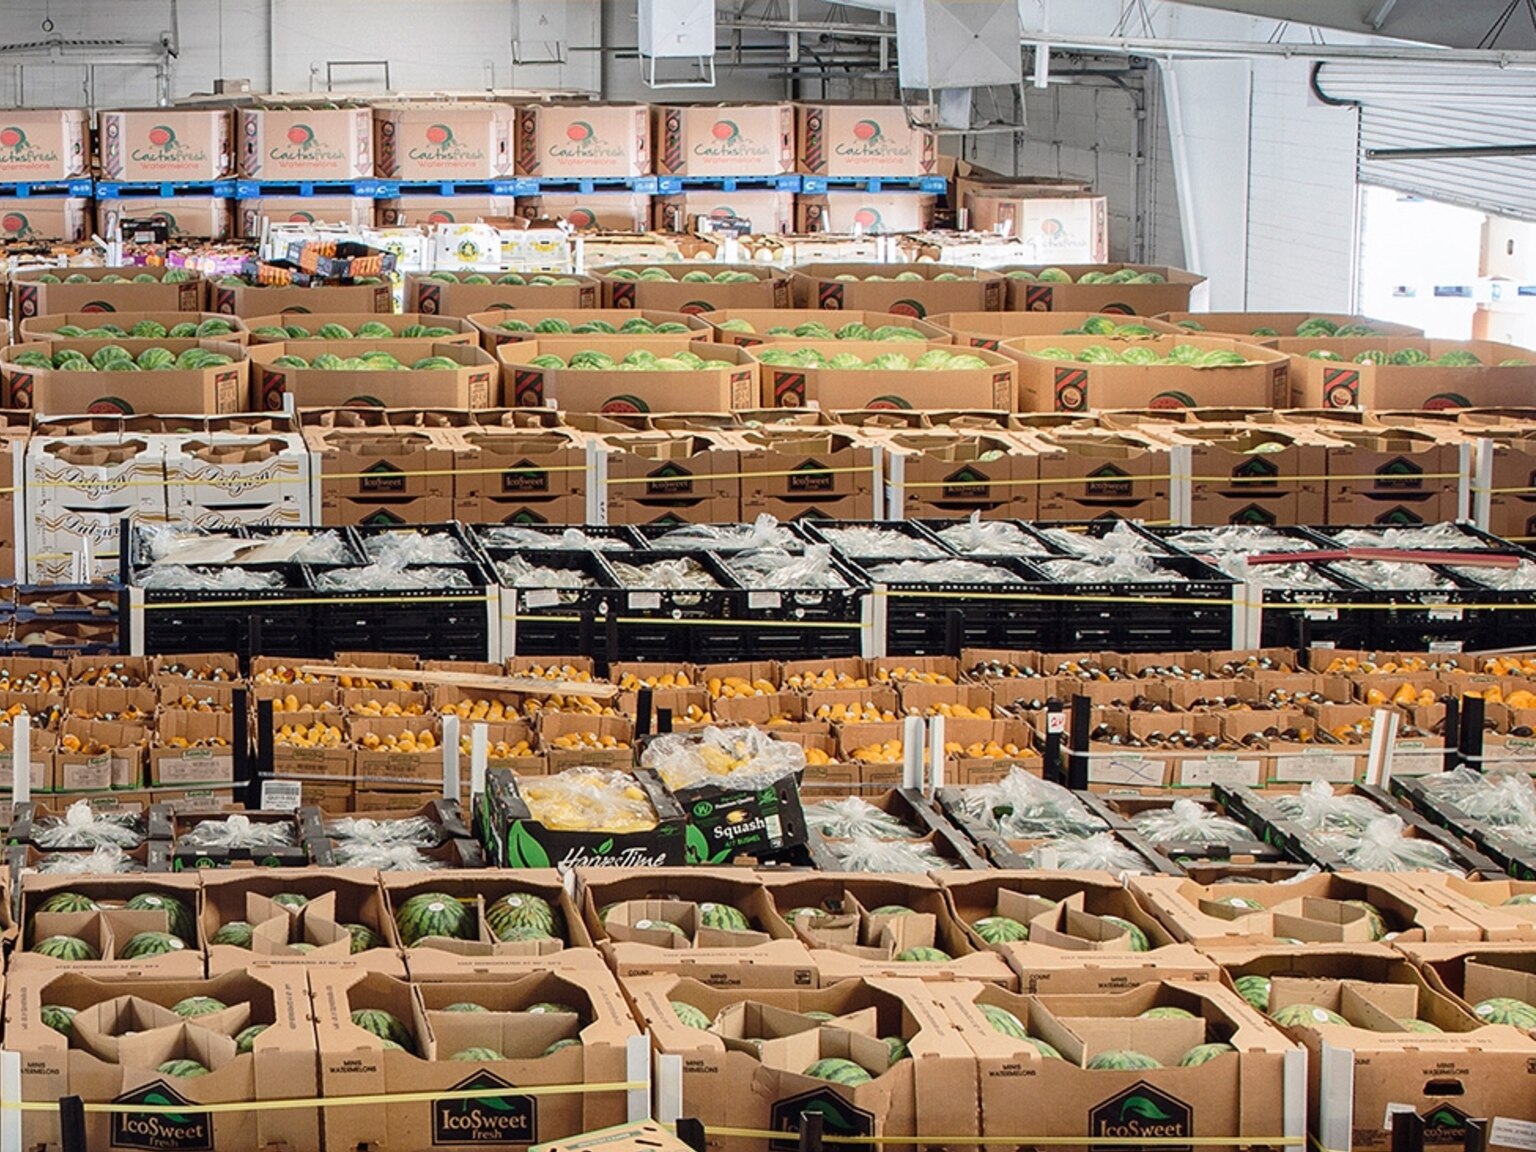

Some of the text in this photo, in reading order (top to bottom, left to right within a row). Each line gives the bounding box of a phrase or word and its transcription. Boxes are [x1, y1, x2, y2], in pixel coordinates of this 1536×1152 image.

[714, 818, 765, 839] Squash
[330, 1066, 376, 1074] WATERMELONS
[121, 1114, 203, 1140] IcoSweet
[442, 1110, 526, 1131] IcoSweet
